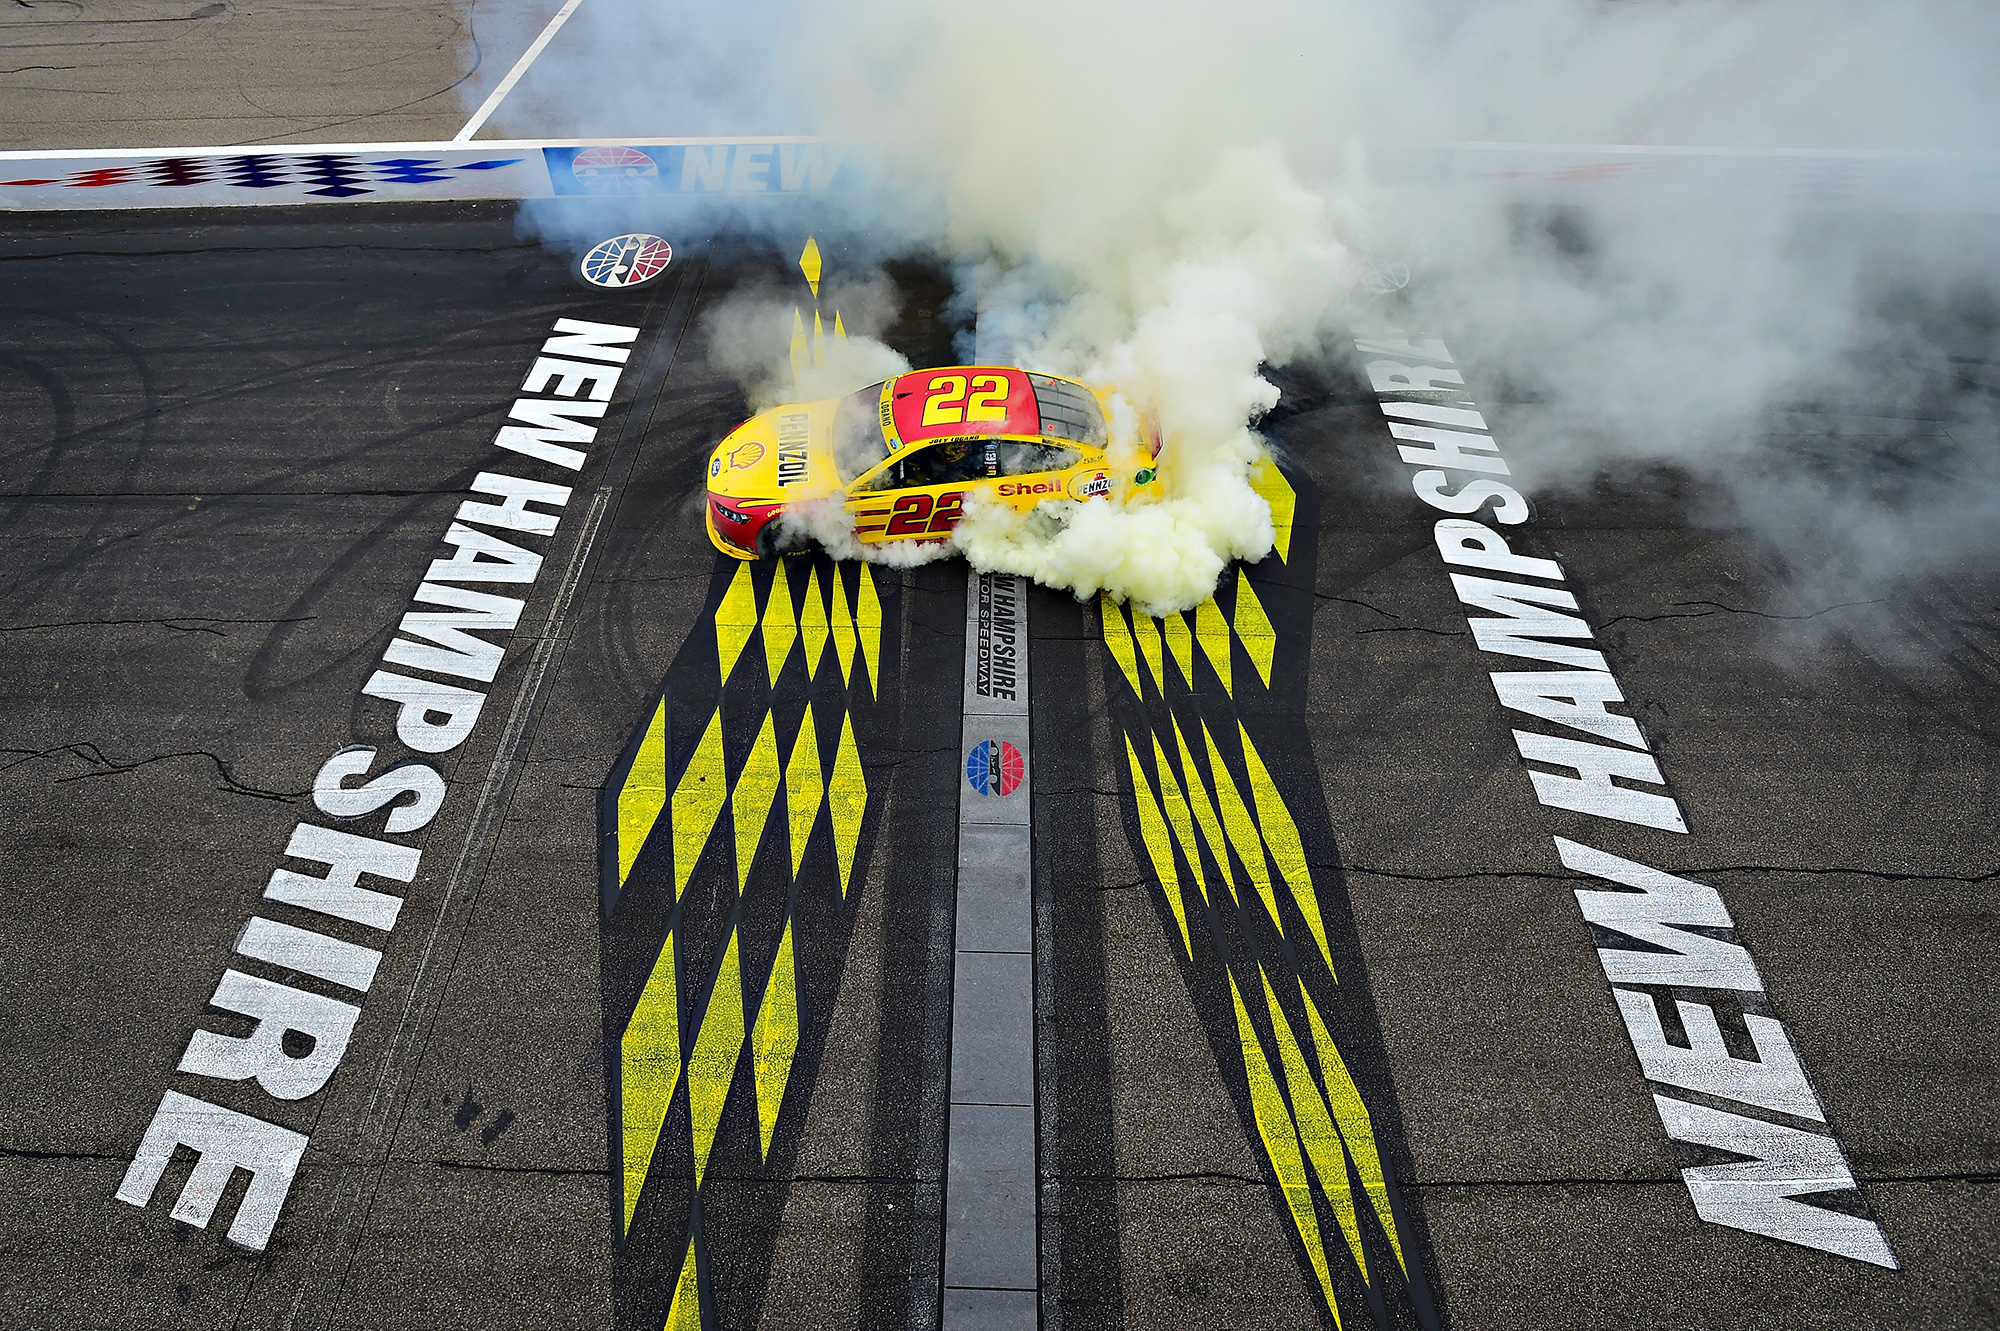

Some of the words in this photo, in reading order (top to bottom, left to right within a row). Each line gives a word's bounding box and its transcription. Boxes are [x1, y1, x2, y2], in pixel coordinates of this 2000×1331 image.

[679, 144, 843, 192] NEW
[494, 317, 640, 471] NEW
[880, 400, 892, 427] LOGANO
[921, 375, 1009, 428] 22
[777, 411, 810, 488] PENNZOIL
[885, 490, 964, 536] 22
[998, 479, 1062, 497] Shell
[980, 575, 990, 604] TOR
[977, 610, 990, 695] SPEEDWAY
[993, 594, 1016, 701] HAMPSHIRE
[115, 471, 573, 1251] HAMPSHIRE
[1553, 835, 1898, 1269] NEW
